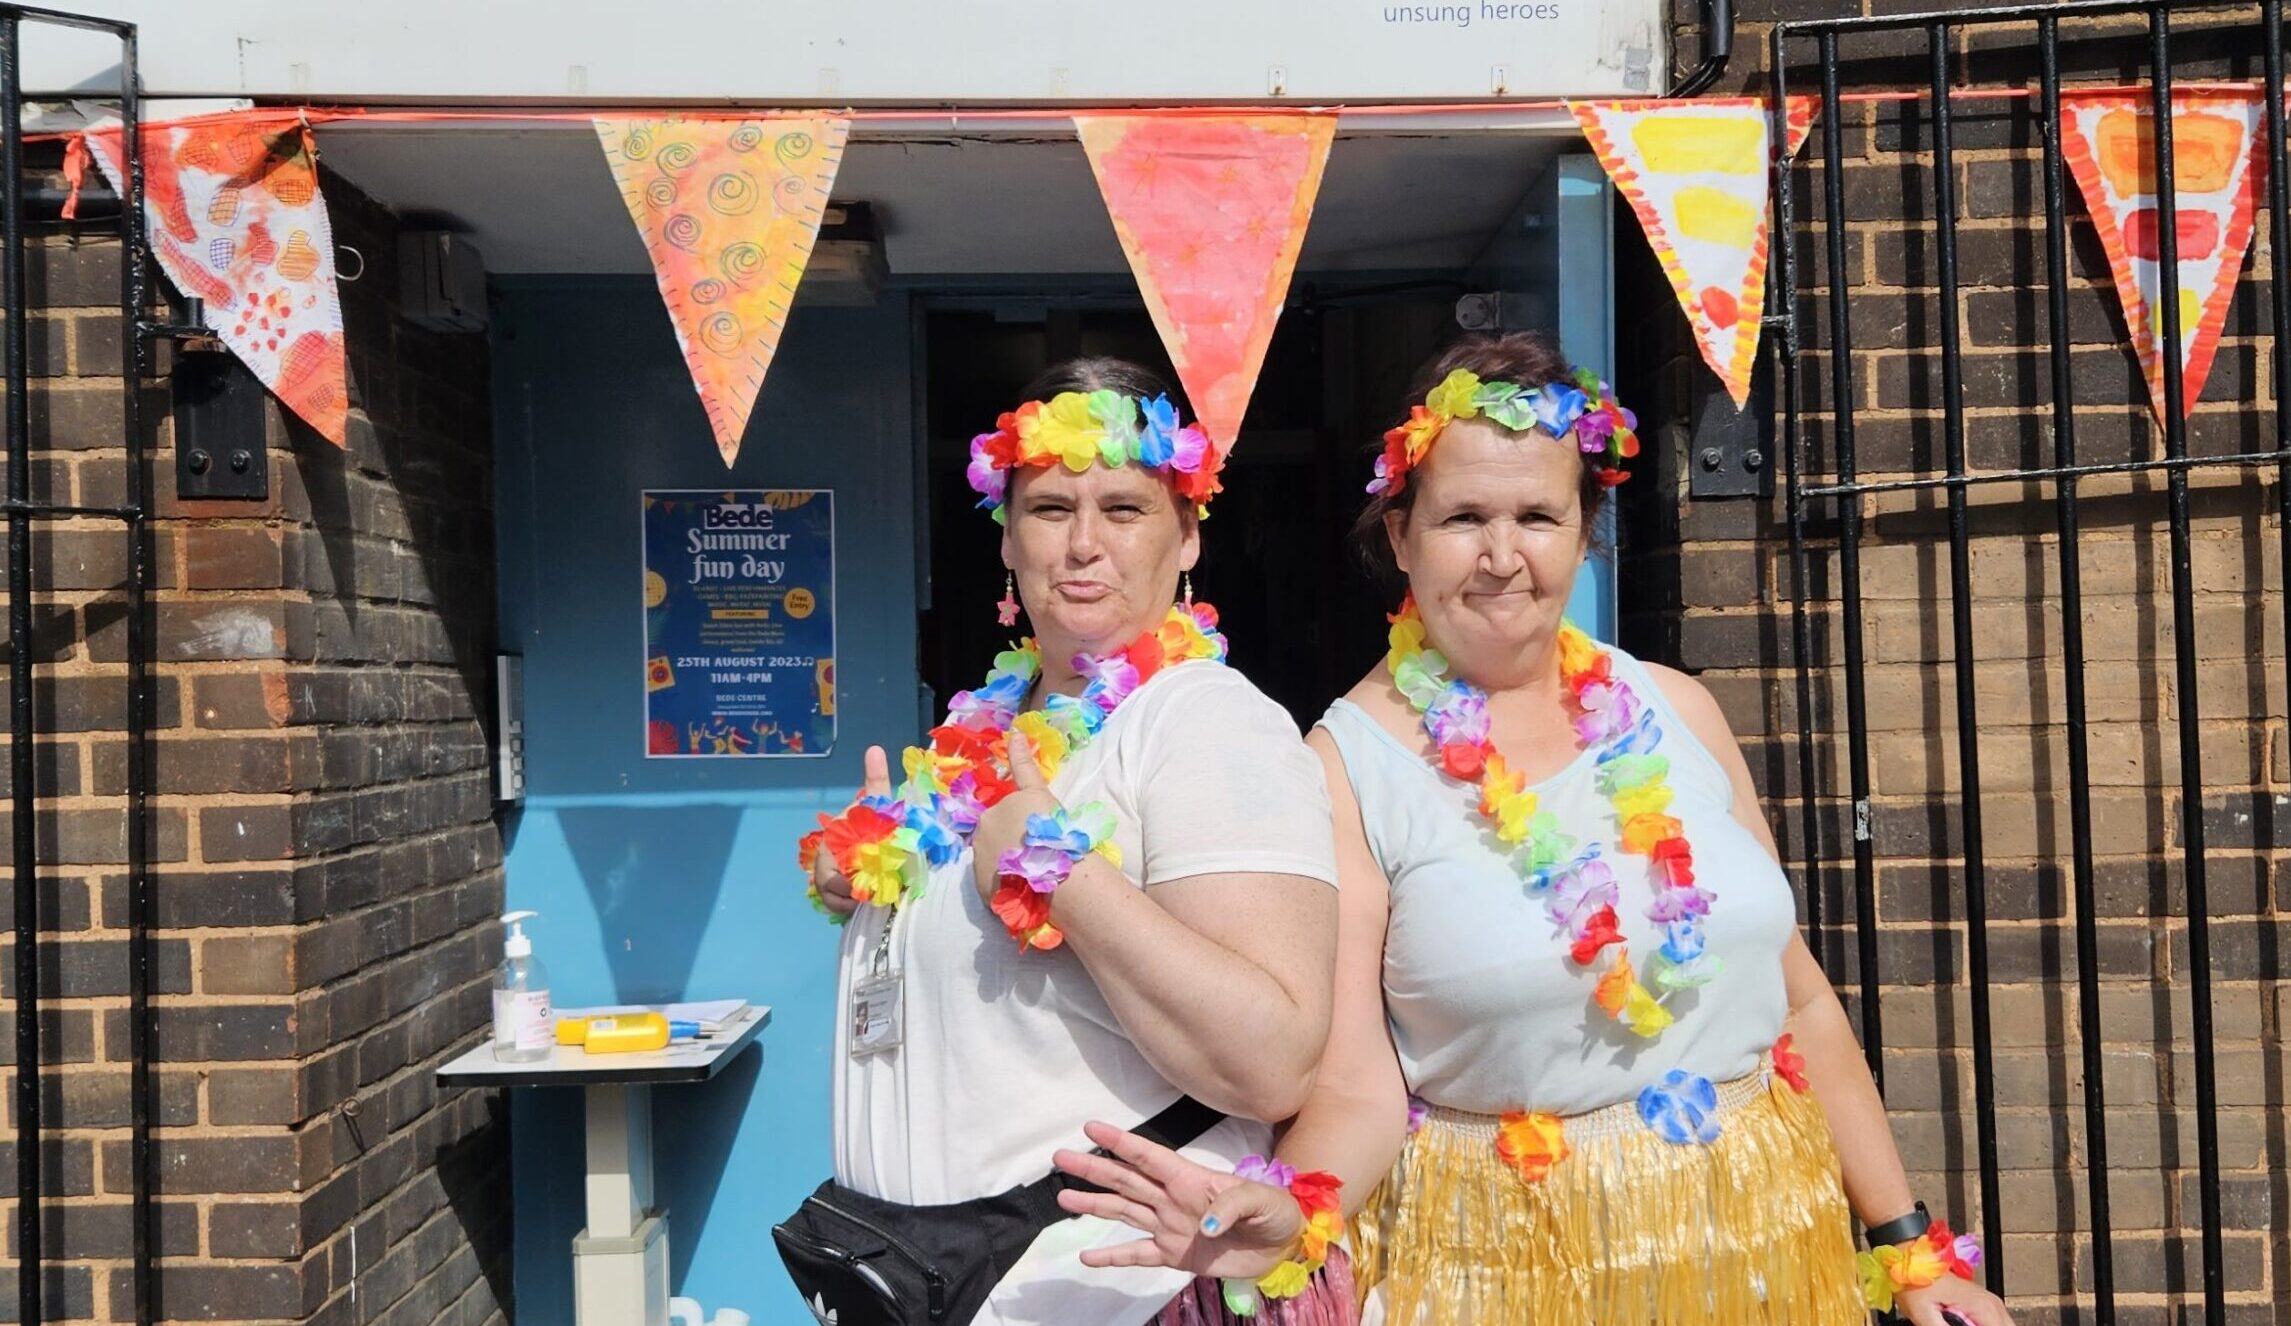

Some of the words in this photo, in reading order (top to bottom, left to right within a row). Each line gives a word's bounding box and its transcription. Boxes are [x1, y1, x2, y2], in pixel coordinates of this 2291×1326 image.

[1384, 5, 1471, 27] unsung
[1481, 0, 1560, 20] heroes
[706, 504, 772, 528] Bede
[687, 528, 791, 554] Summer
[688, 554, 735, 584] fun
[741, 554, 785, 584] day
[790, 601, 809, 610] Entry
[677, 657, 710, 667] 25TH
[714, 657, 765, 667] AUGUST
[768, 656, 802, 667] 2023
[710, 673, 772, 683] 11AM-4PM
[737, 694, 767, 702] CENTRE
